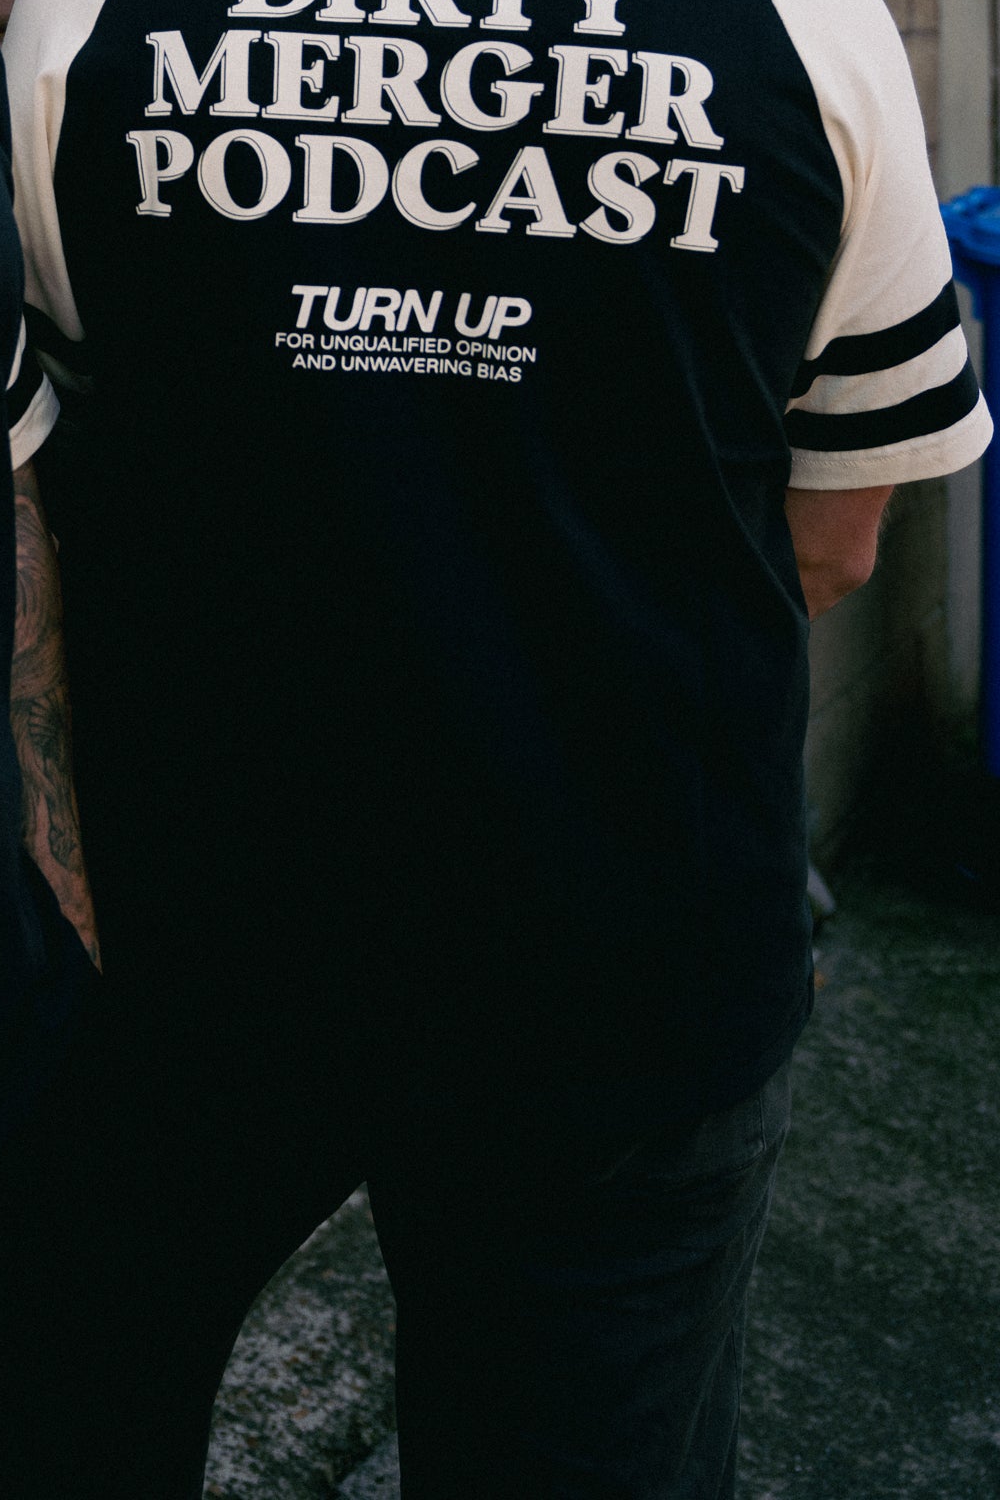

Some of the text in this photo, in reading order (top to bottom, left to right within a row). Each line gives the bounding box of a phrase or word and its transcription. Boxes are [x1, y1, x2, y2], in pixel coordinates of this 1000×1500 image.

[144, 29, 725, 151] MERGER
[125, 129, 746, 253] PODCAST
[291, 284, 533, 340] TURN UP
[275, 332, 538, 364] FOR UNQUALIFIED OPINION
[292, 353, 522, 383] AND UNWAVERING BIAS
